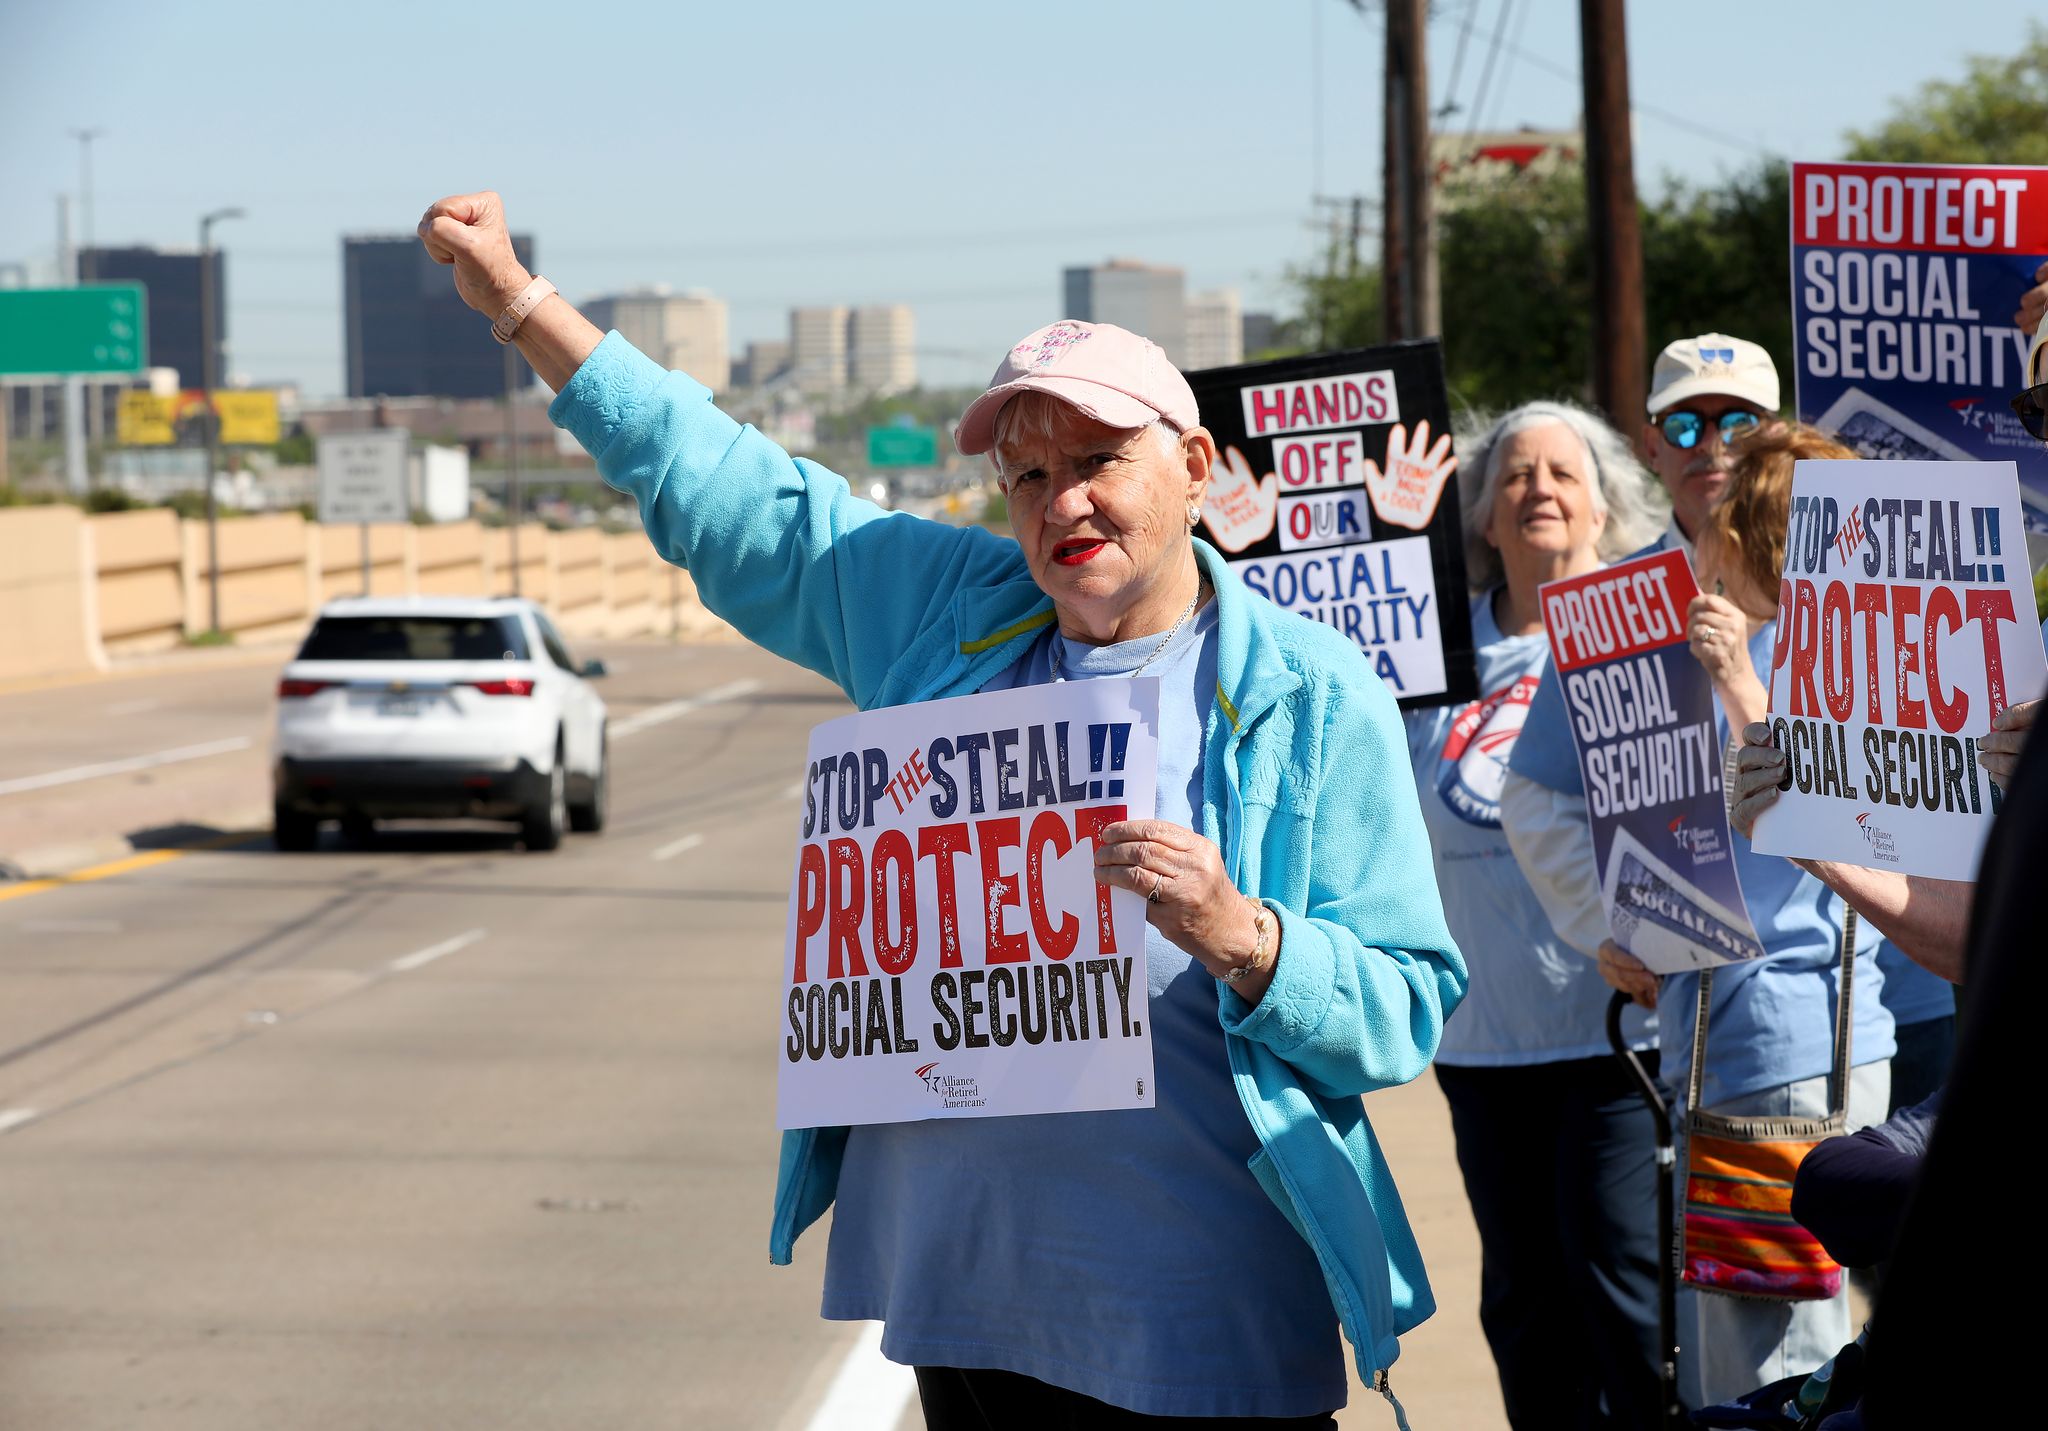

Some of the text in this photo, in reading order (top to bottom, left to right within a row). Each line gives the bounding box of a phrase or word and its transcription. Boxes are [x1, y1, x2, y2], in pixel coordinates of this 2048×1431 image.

[1805, 173, 2027, 248] PROTECT
[1804, 250, 1980, 320] SOCIAL
[1252, 378, 1387, 433] HANDS
[1281, 440, 1356, 486] OFF
[1289, 500, 1361, 541] OUR
[1834, 505, 1865, 567] THE
[1863, 497, 2005, 583] STEAL!!
[1243, 549, 1406, 608] SOCIAL
[1547, 566, 1682, 664] PROTECT
[1768, 578, 2017, 733] PROTECT
[1567, 653, 1678, 743] SOCIAL
[803, 721, 1132, 839] STOP THE STEAL!!
[1586, 721, 1719, 818] SECURITY.
[1766, 715, 1858, 800] OCIAL
[793, 805, 1127, 984] PROTECT
[1630, 886, 1713, 939] SOCIAL
[786, 957, 1142, 1063] SOCIAL SECURITY.
[941, 1076, 975, 1087] Alliance
[948, 1086, 978, 1097] Retired
